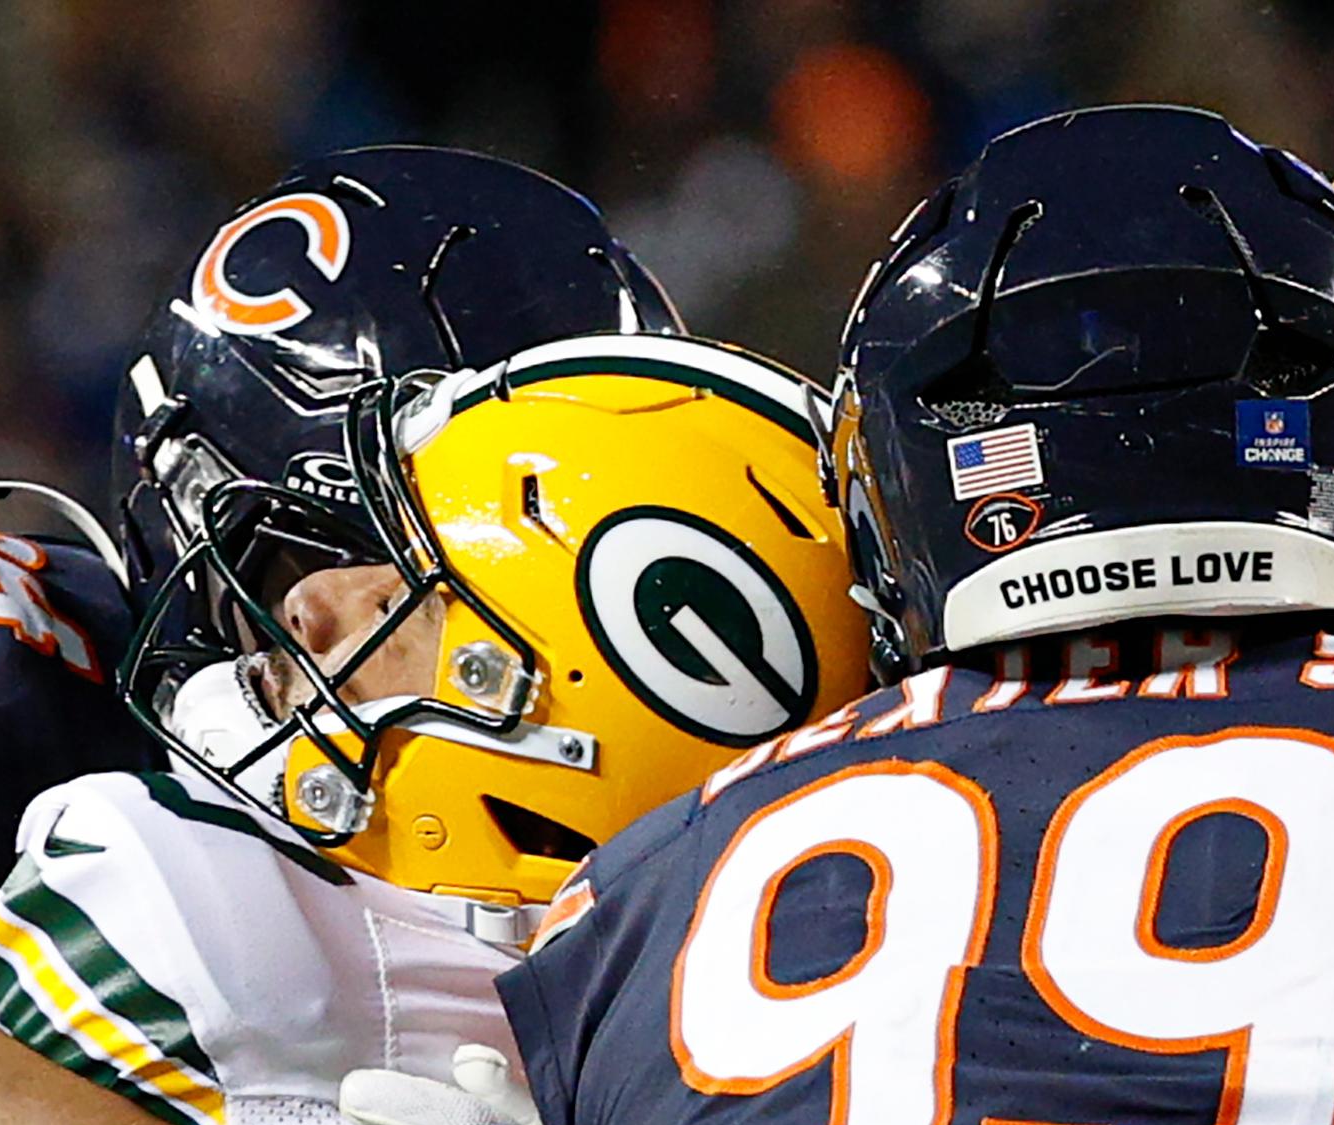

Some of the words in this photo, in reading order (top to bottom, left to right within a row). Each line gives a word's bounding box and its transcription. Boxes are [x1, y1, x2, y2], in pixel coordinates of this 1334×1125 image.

[191, 192, 351, 335] C
[286, 475, 362, 505] OAKLE
[987, 511, 1017, 546] 76
[1000, 558, 1157, 609] CHOOSE
[1170, 550, 1274, 587] LOVE
[575, 504, 818, 748] G
